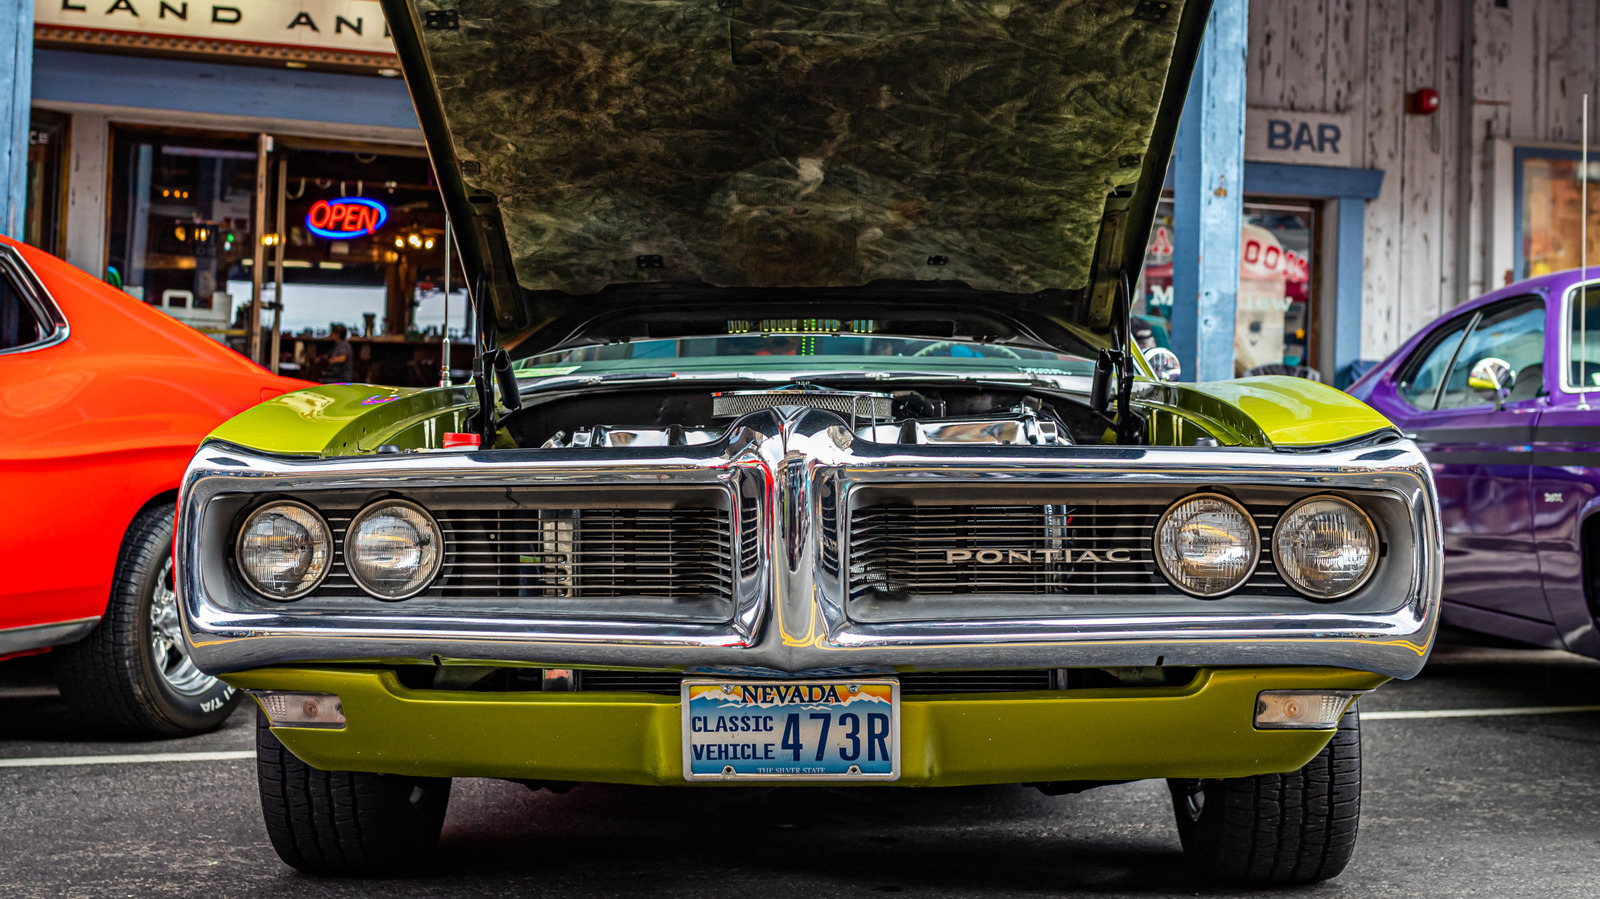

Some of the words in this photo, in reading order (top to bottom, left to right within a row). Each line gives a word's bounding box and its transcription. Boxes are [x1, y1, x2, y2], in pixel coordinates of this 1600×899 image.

[62, 0, 243, 24] LAND
[287, 12, 391, 37] AN
[1267, 119, 1342, 154] BAR
[309, 200, 379, 234] OPEN
[946, 549, 1131, 564] PONTIAC
[740, 685, 842, 704] NEVADA
[200, 697, 224, 713] T/A
[692, 715, 774, 733] CLASSIC
[781, 712, 890, 762] 473R
[692, 743, 776, 761] VEHICLE
